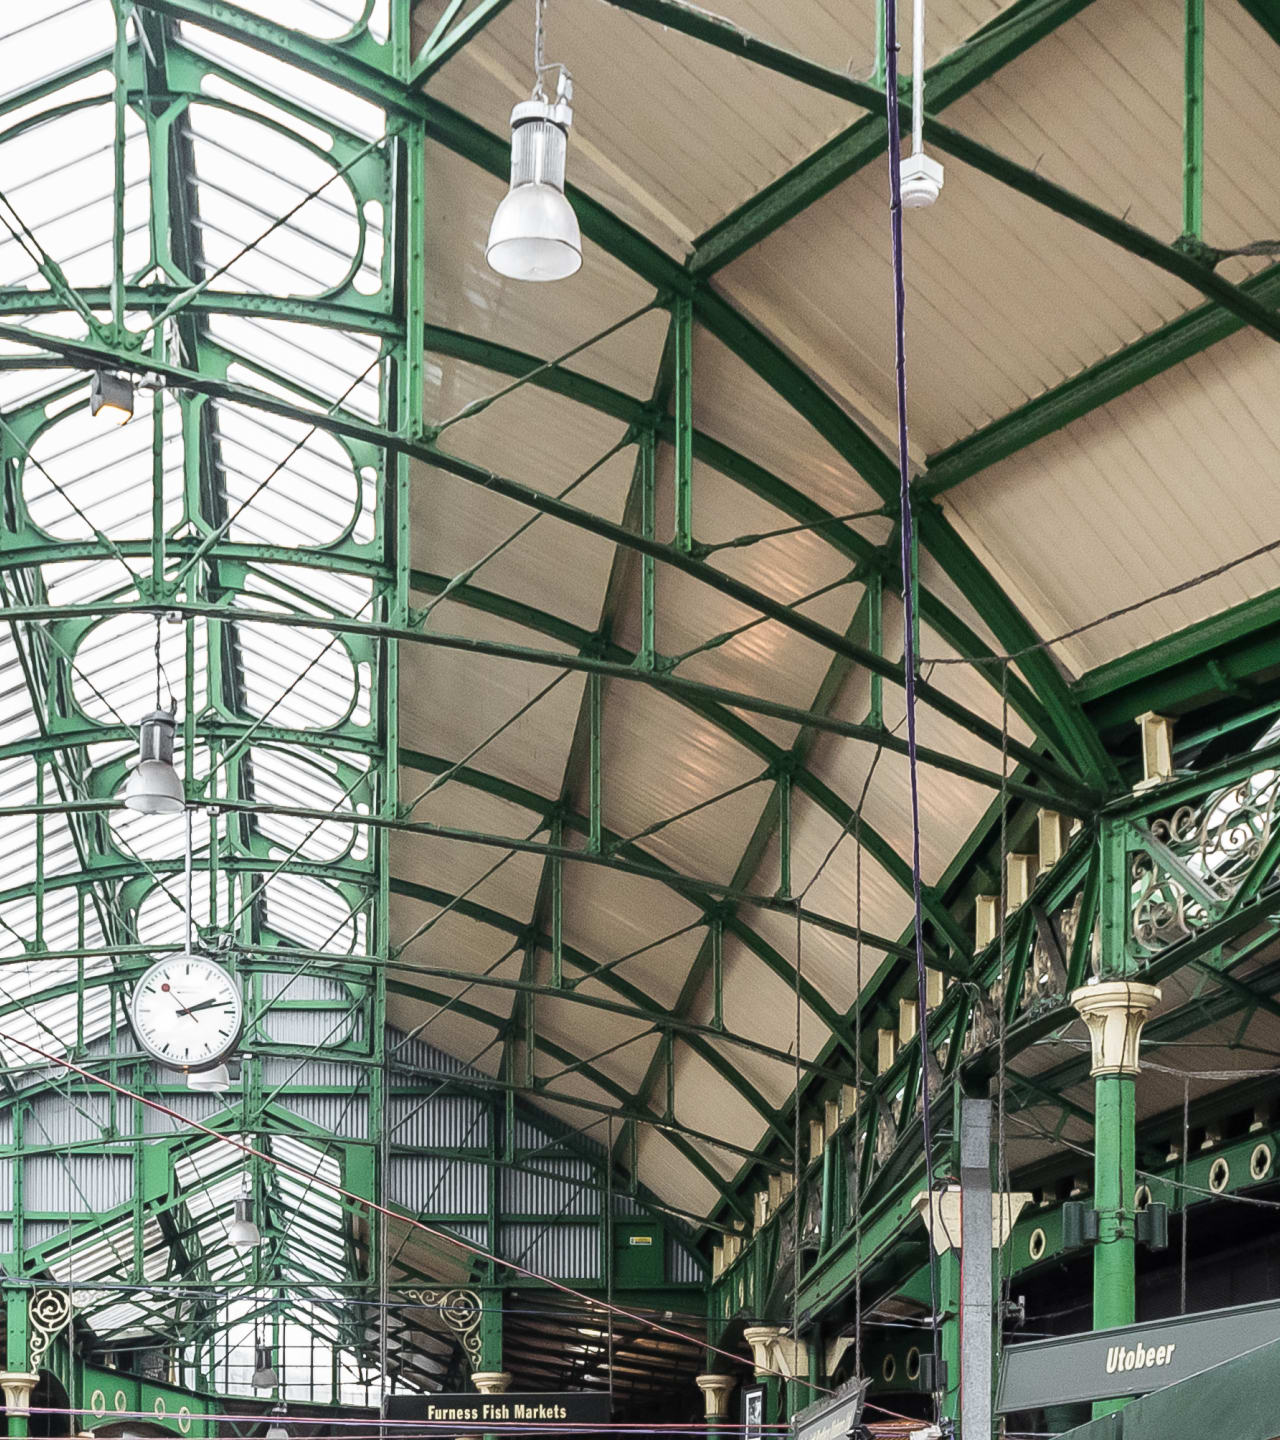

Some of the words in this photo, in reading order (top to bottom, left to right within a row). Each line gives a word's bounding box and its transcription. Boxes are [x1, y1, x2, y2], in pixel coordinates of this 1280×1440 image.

[1106, 1342, 1175, 1373] Utobeer
[428, 1405, 478, 1420] Furness
[483, 1404, 509, 1419] Fish
[514, 1404, 567, 1419] Markets
